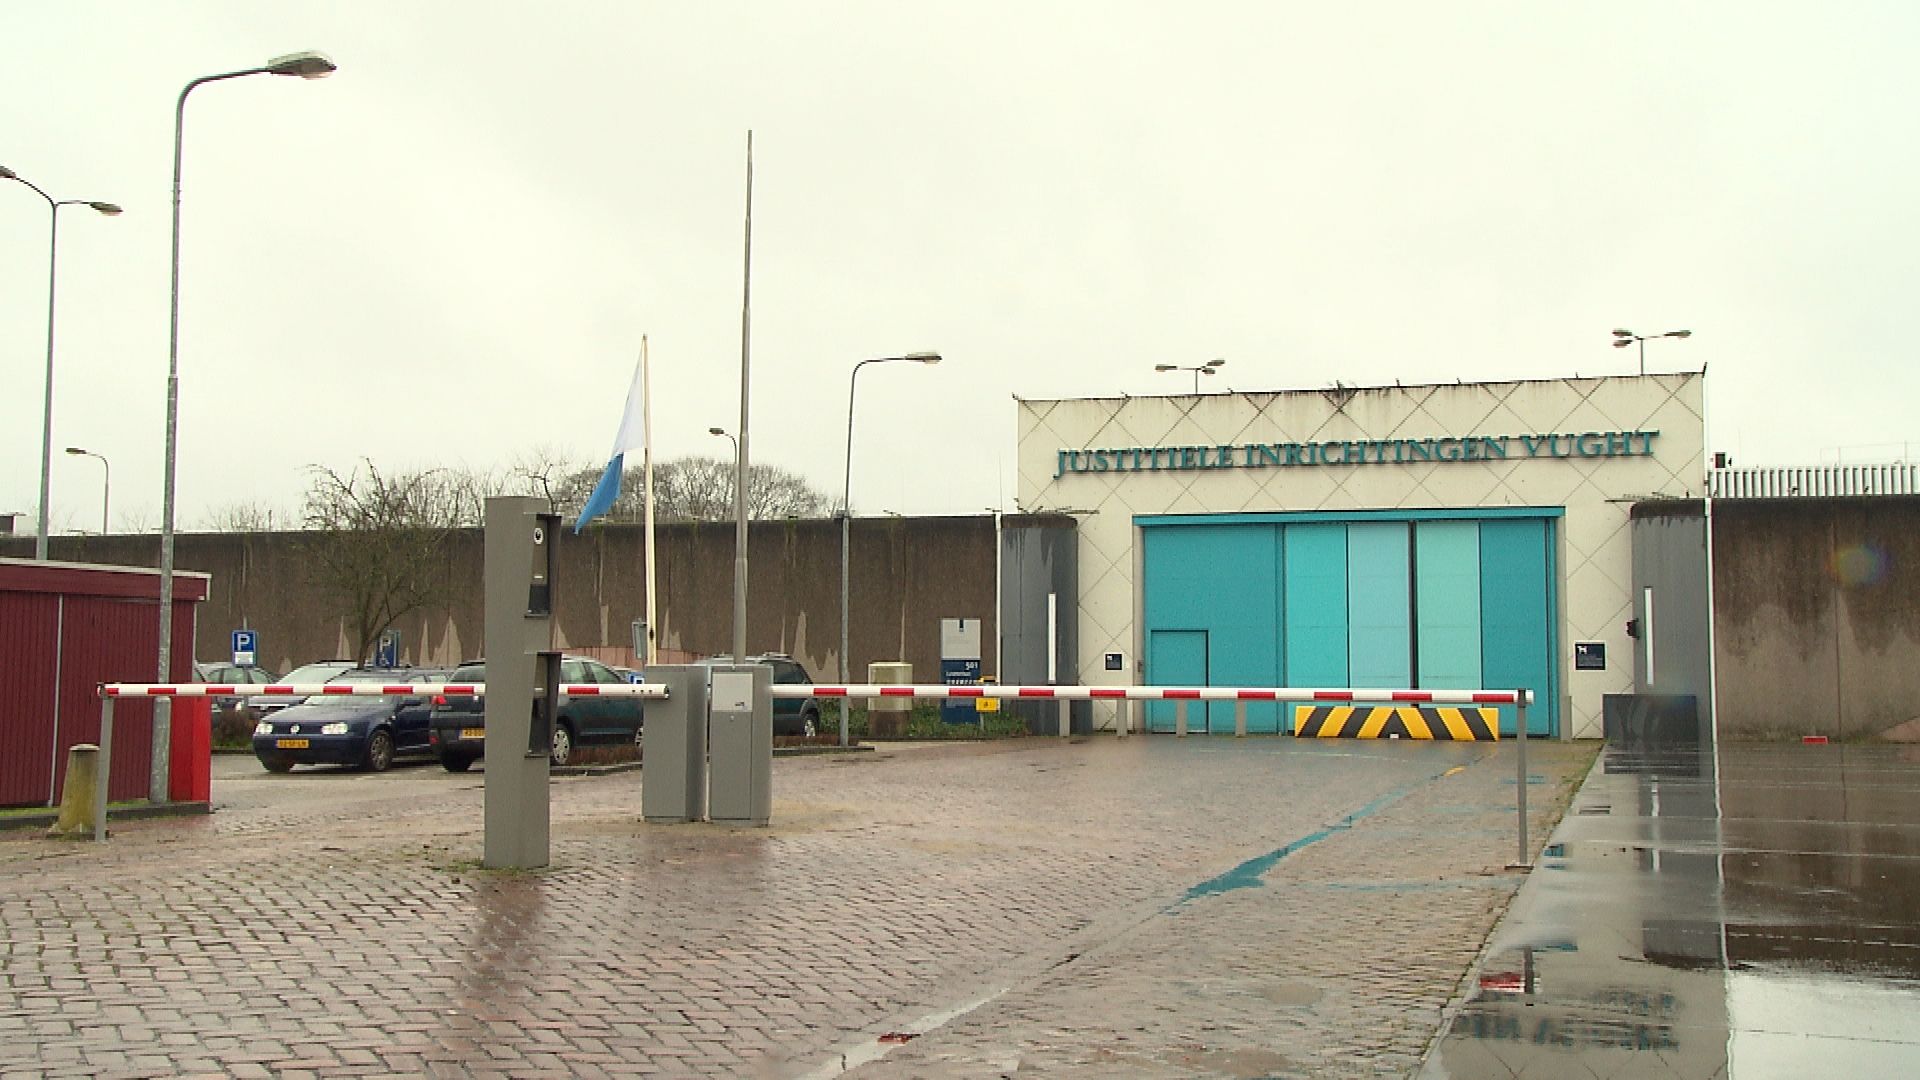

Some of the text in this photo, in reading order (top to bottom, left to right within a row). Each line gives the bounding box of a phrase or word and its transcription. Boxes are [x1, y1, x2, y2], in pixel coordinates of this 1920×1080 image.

[1053, 430, 1660, 480] JUSTITIELE INRICHTINGEN VUGHT
[237, 633, 251, 651] P
[379, 635, 392, 652] P
